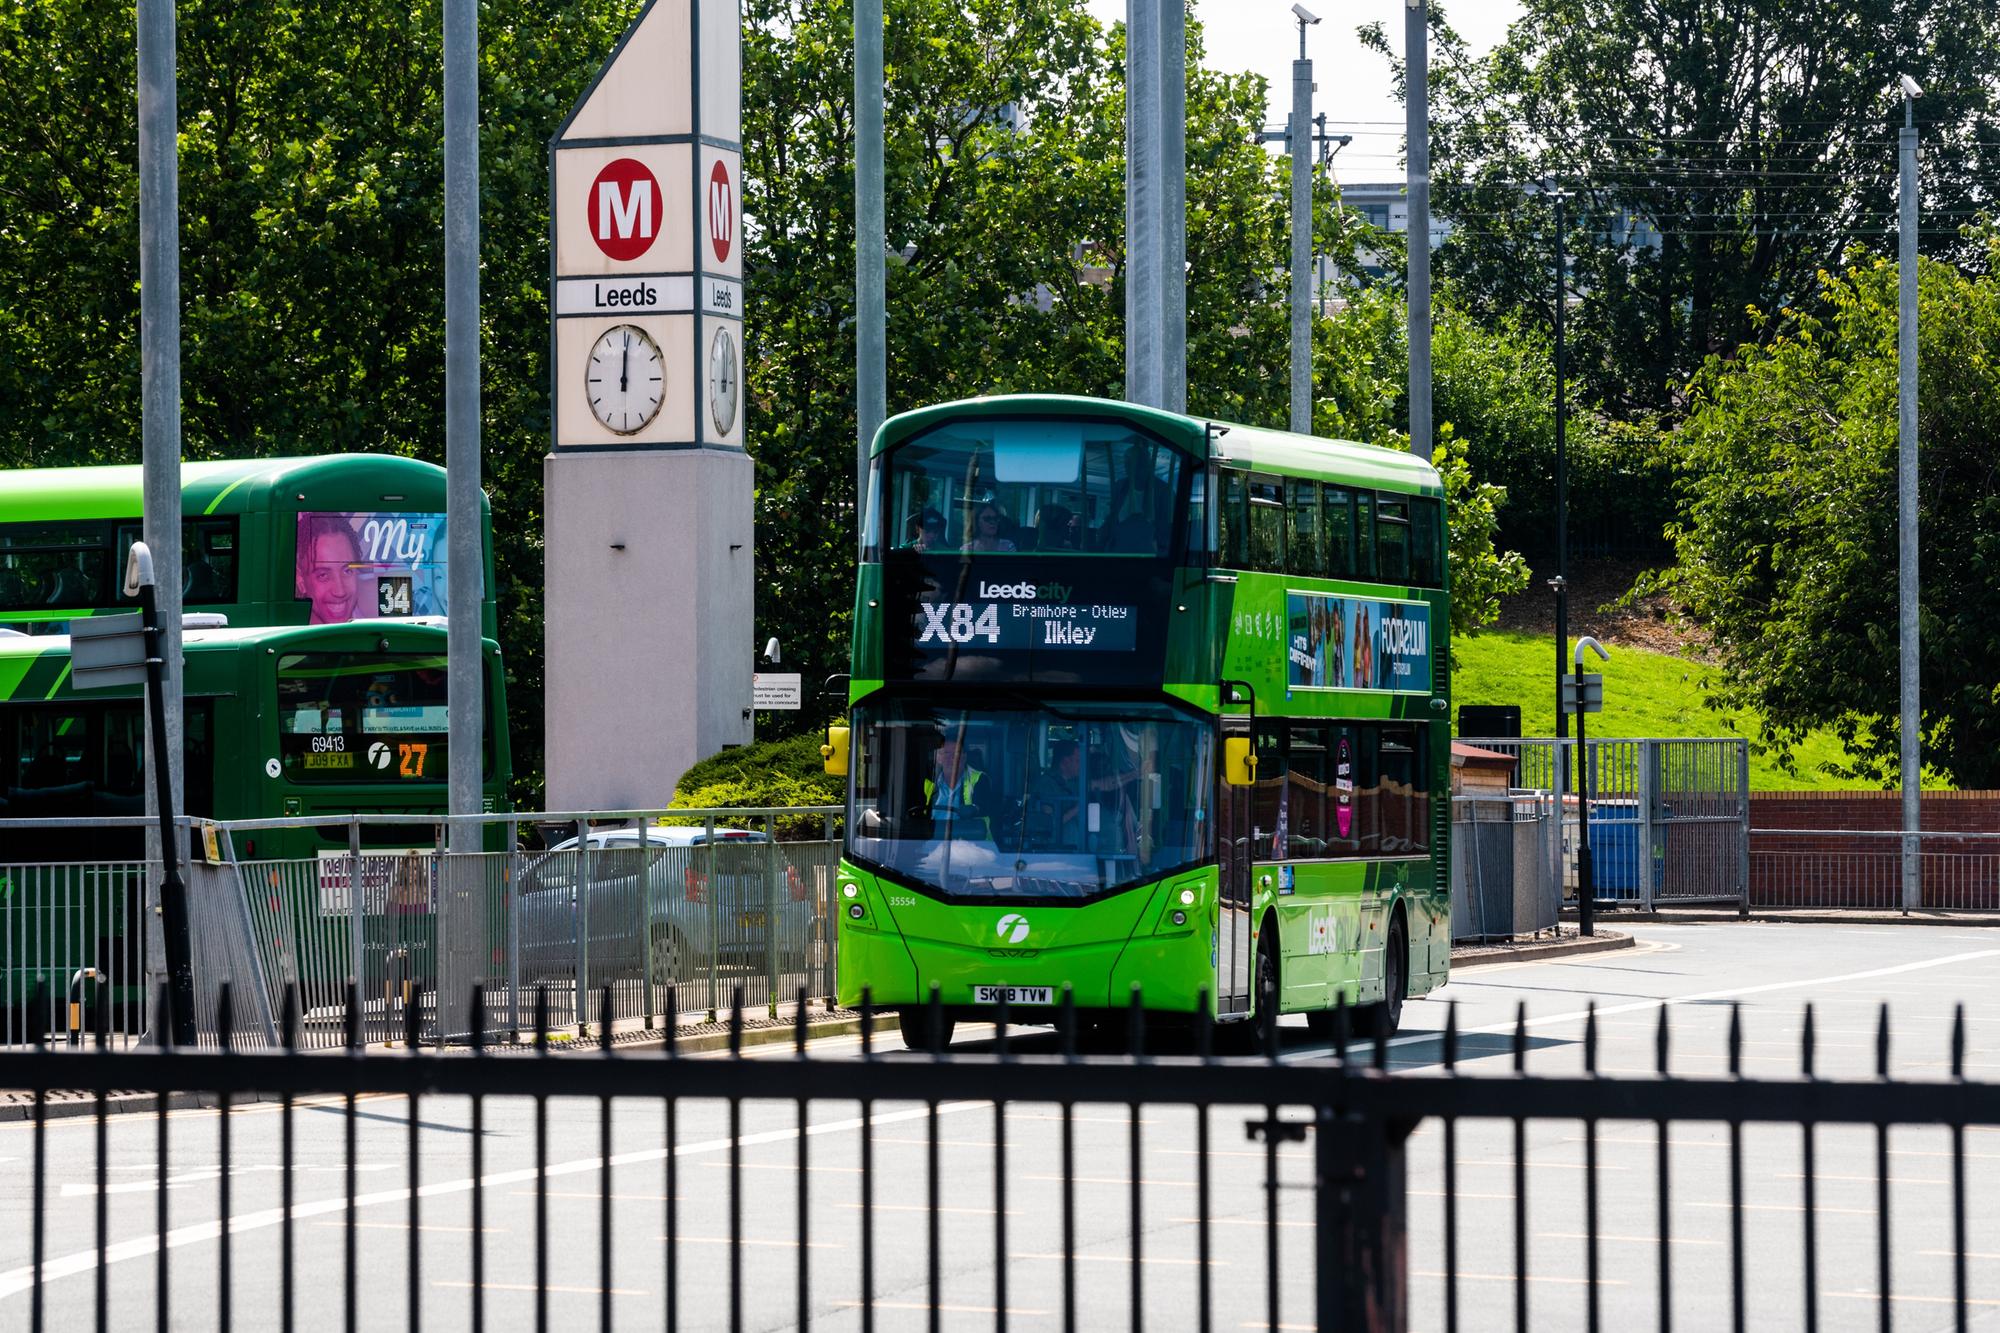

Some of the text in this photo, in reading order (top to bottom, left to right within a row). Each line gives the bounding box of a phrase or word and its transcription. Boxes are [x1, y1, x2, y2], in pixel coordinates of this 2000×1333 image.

[598, 179, 652, 240] M
[711, 181, 729, 241] M
[595, 282, 657, 307] Leeds
[712, 282, 732, 309] Leeds
[364, 518, 425, 571] My
[379, 582, 410, 614] 34
[919, 602, 1001, 644] X84
[1012, 604, 1077, 619] Bramhope
[1092, 604, 1128, 619] Otley
[1044, 620, 1096, 646] Ilkley
[312, 736, 344, 753] 69413
[330, 754, 349, 766] FXA
[399, 744, 427, 777] 27
[890, 896, 916, 907] 35554
[980, 987, 1047, 1002] SK8 TVW
